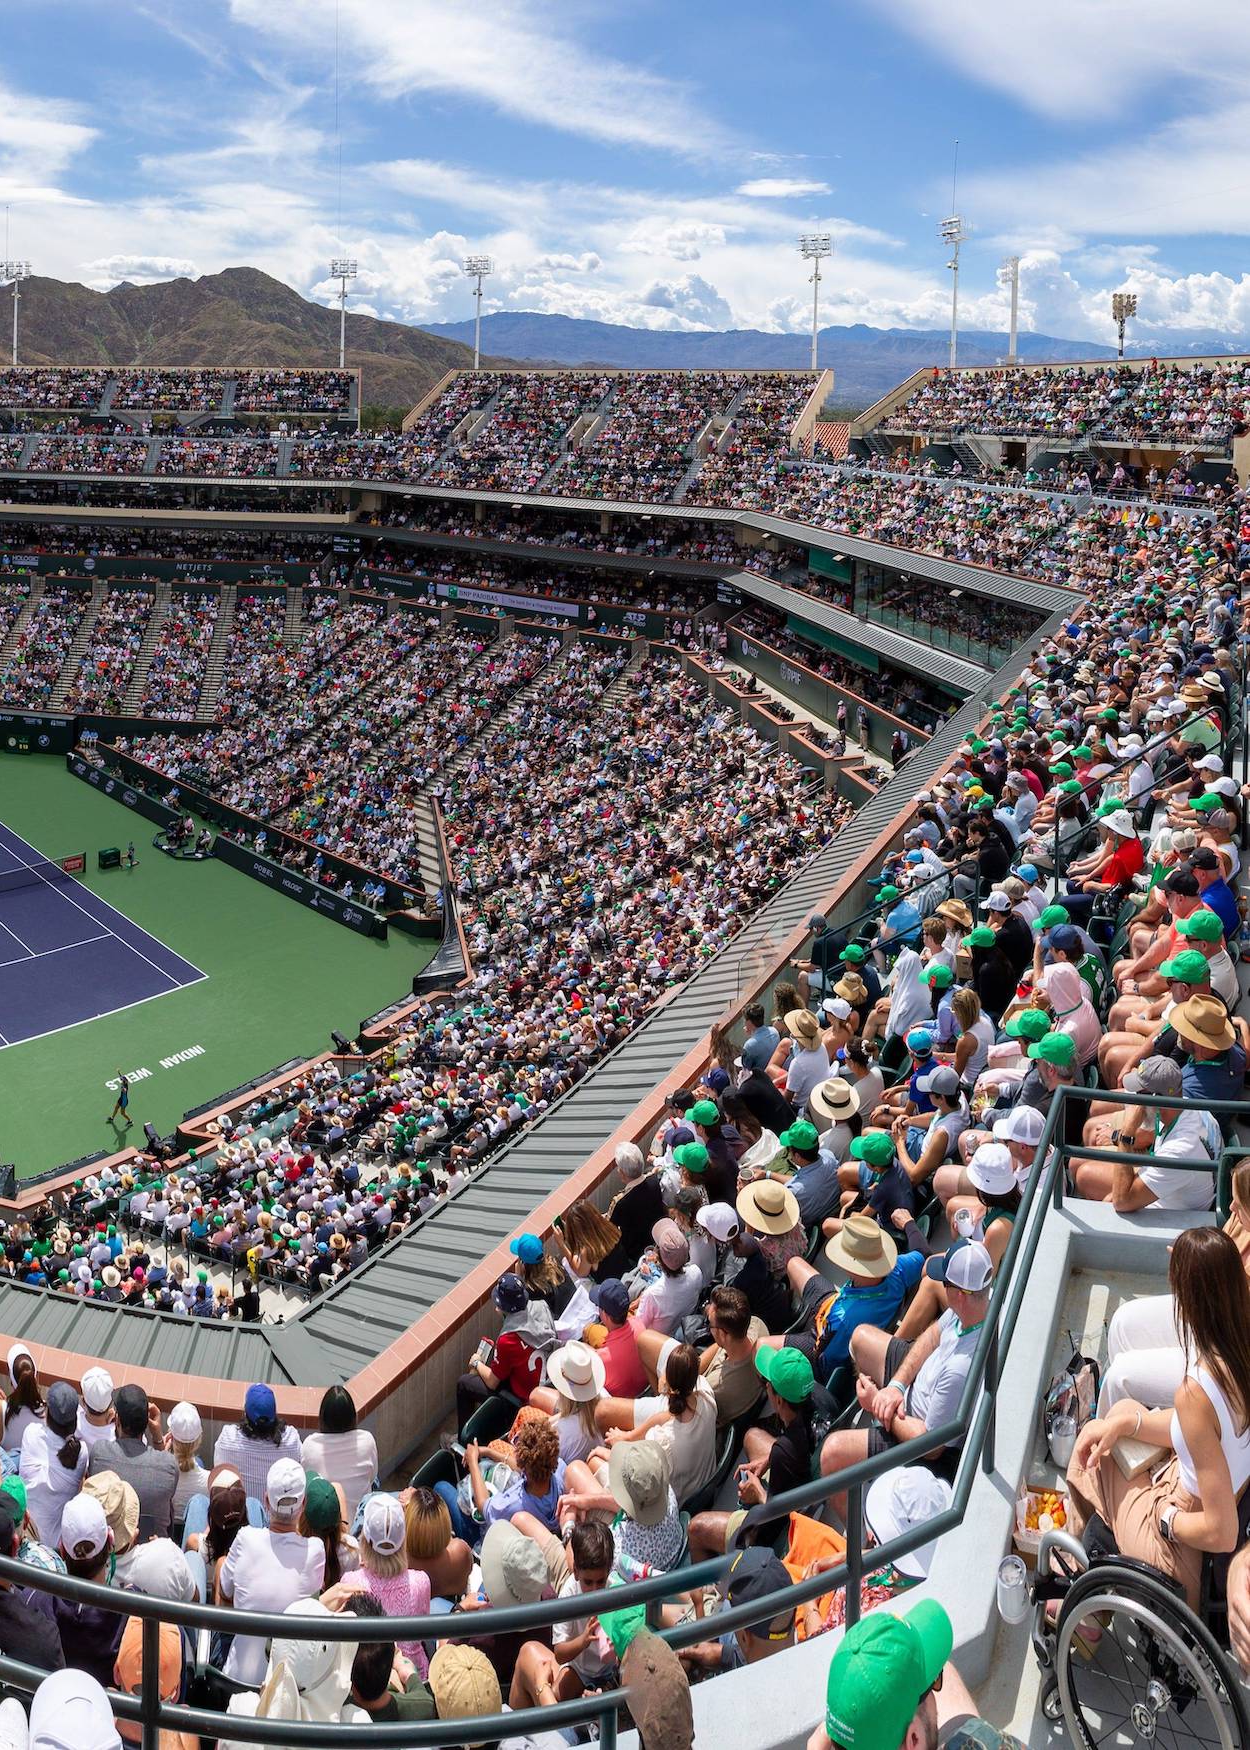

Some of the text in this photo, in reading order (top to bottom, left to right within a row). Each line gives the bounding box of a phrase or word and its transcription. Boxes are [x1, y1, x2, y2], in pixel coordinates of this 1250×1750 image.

[176, 563, 213, 571] NETJETS
[472, 592, 498, 602] PARIBAS
[623, 612, 646, 622] ATP
[253, 862, 274, 878] DOBEL
[282, 879, 303, 893] HOLOGIC
[159, 1045, 206, 1069] INDIAN
